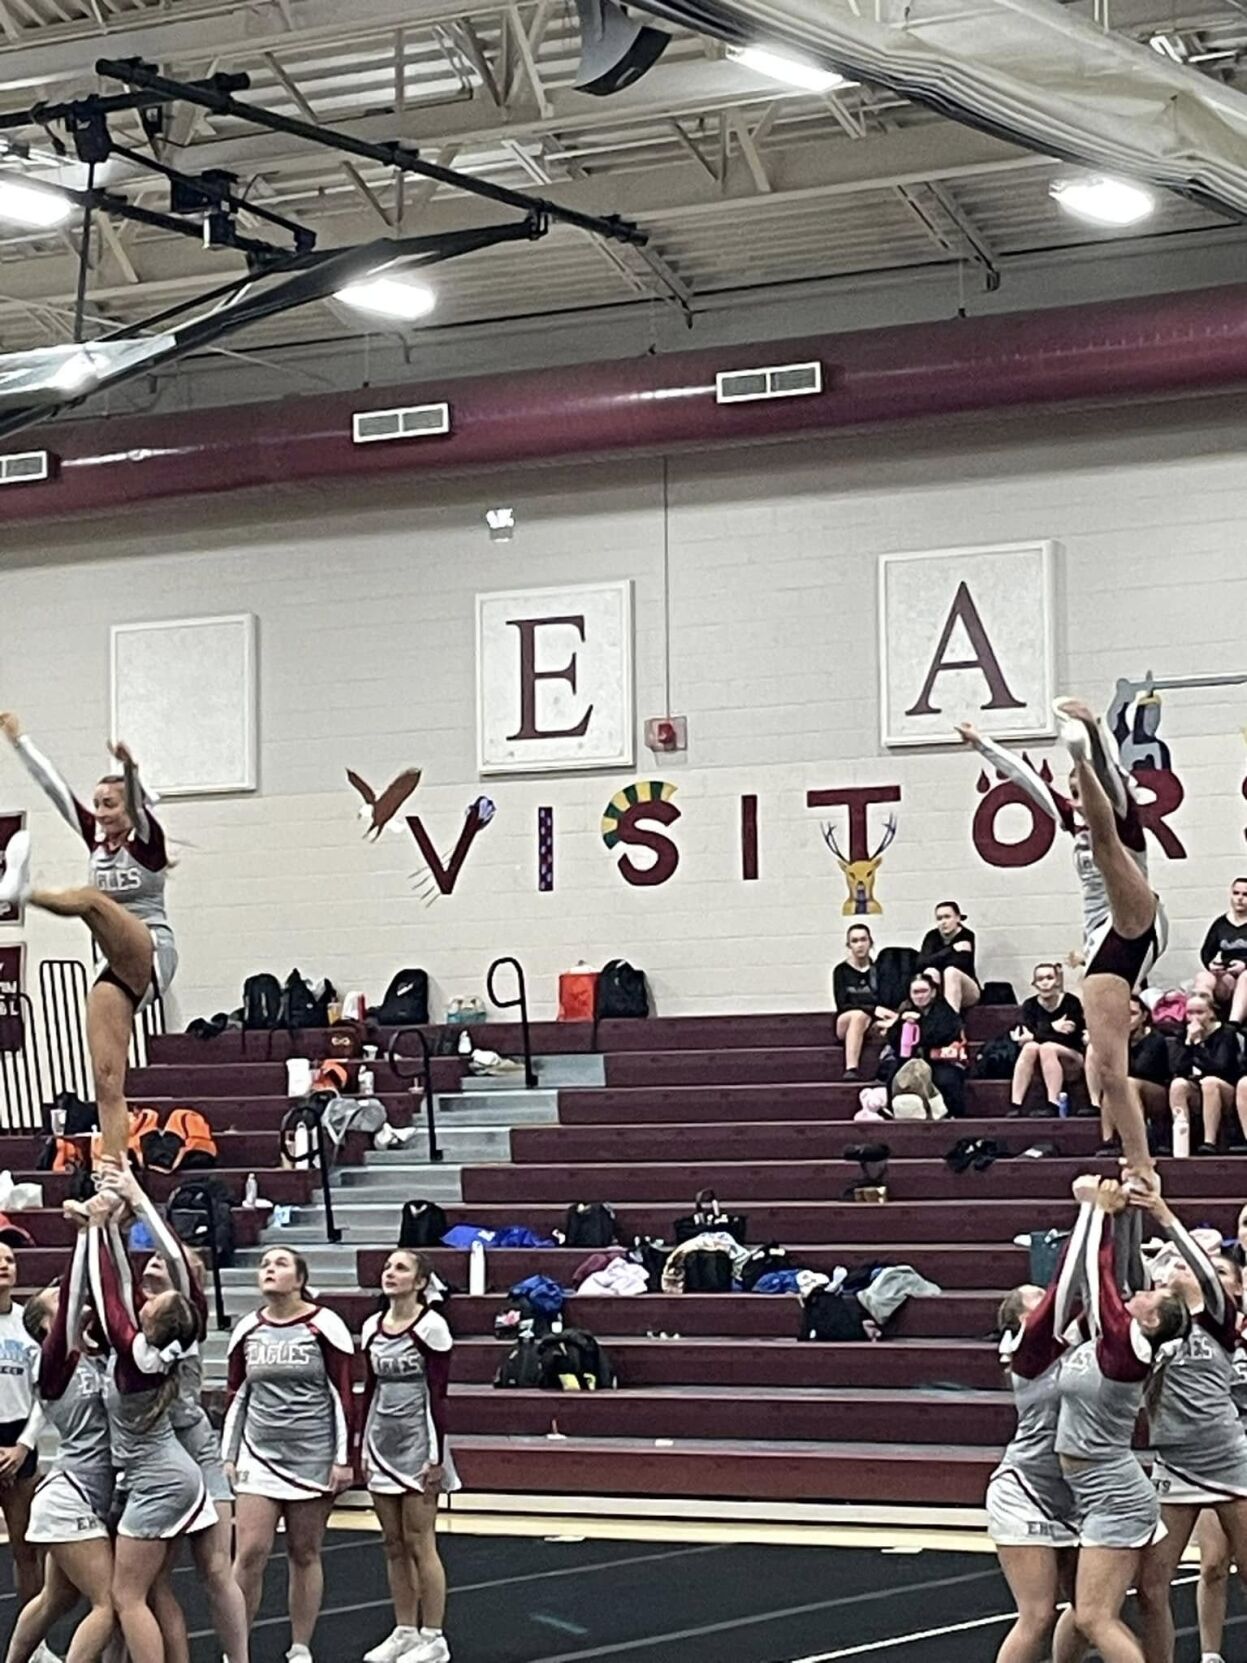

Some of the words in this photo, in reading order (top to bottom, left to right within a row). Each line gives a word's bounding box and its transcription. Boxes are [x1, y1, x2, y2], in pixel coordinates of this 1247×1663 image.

[505, 614, 594, 741] E
[904, 580, 1028, 716] A
[405, 768, 1247, 895] VISITOR
